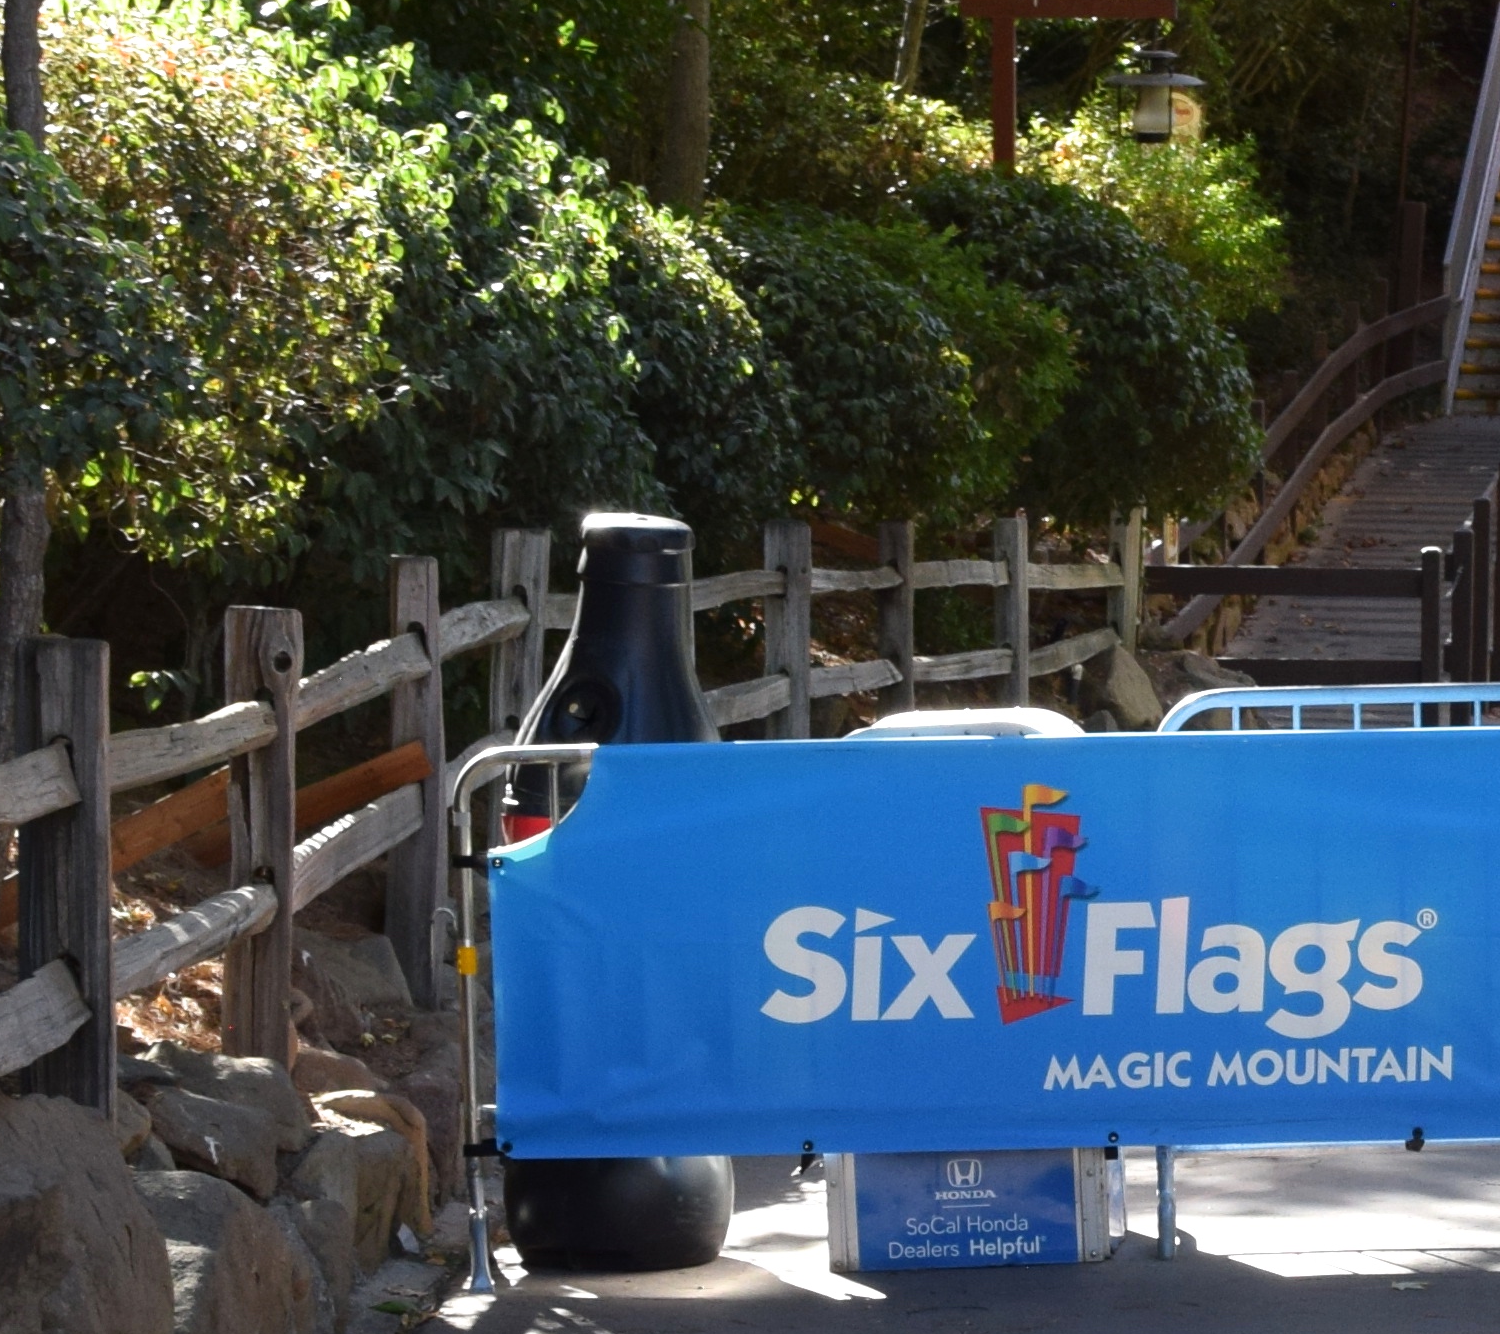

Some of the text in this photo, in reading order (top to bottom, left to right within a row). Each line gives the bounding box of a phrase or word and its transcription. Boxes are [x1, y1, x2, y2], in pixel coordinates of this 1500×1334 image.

[759, 904, 977, 1025] Six
[1042, 1045, 1454, 1091] MAGIC MOUNTAIN
[934, 1189, 997, 1200] HONDA
[905, 1213, 1029, 1236] SoCal Honda
[888, 1239, 960, 1260] Dealers
